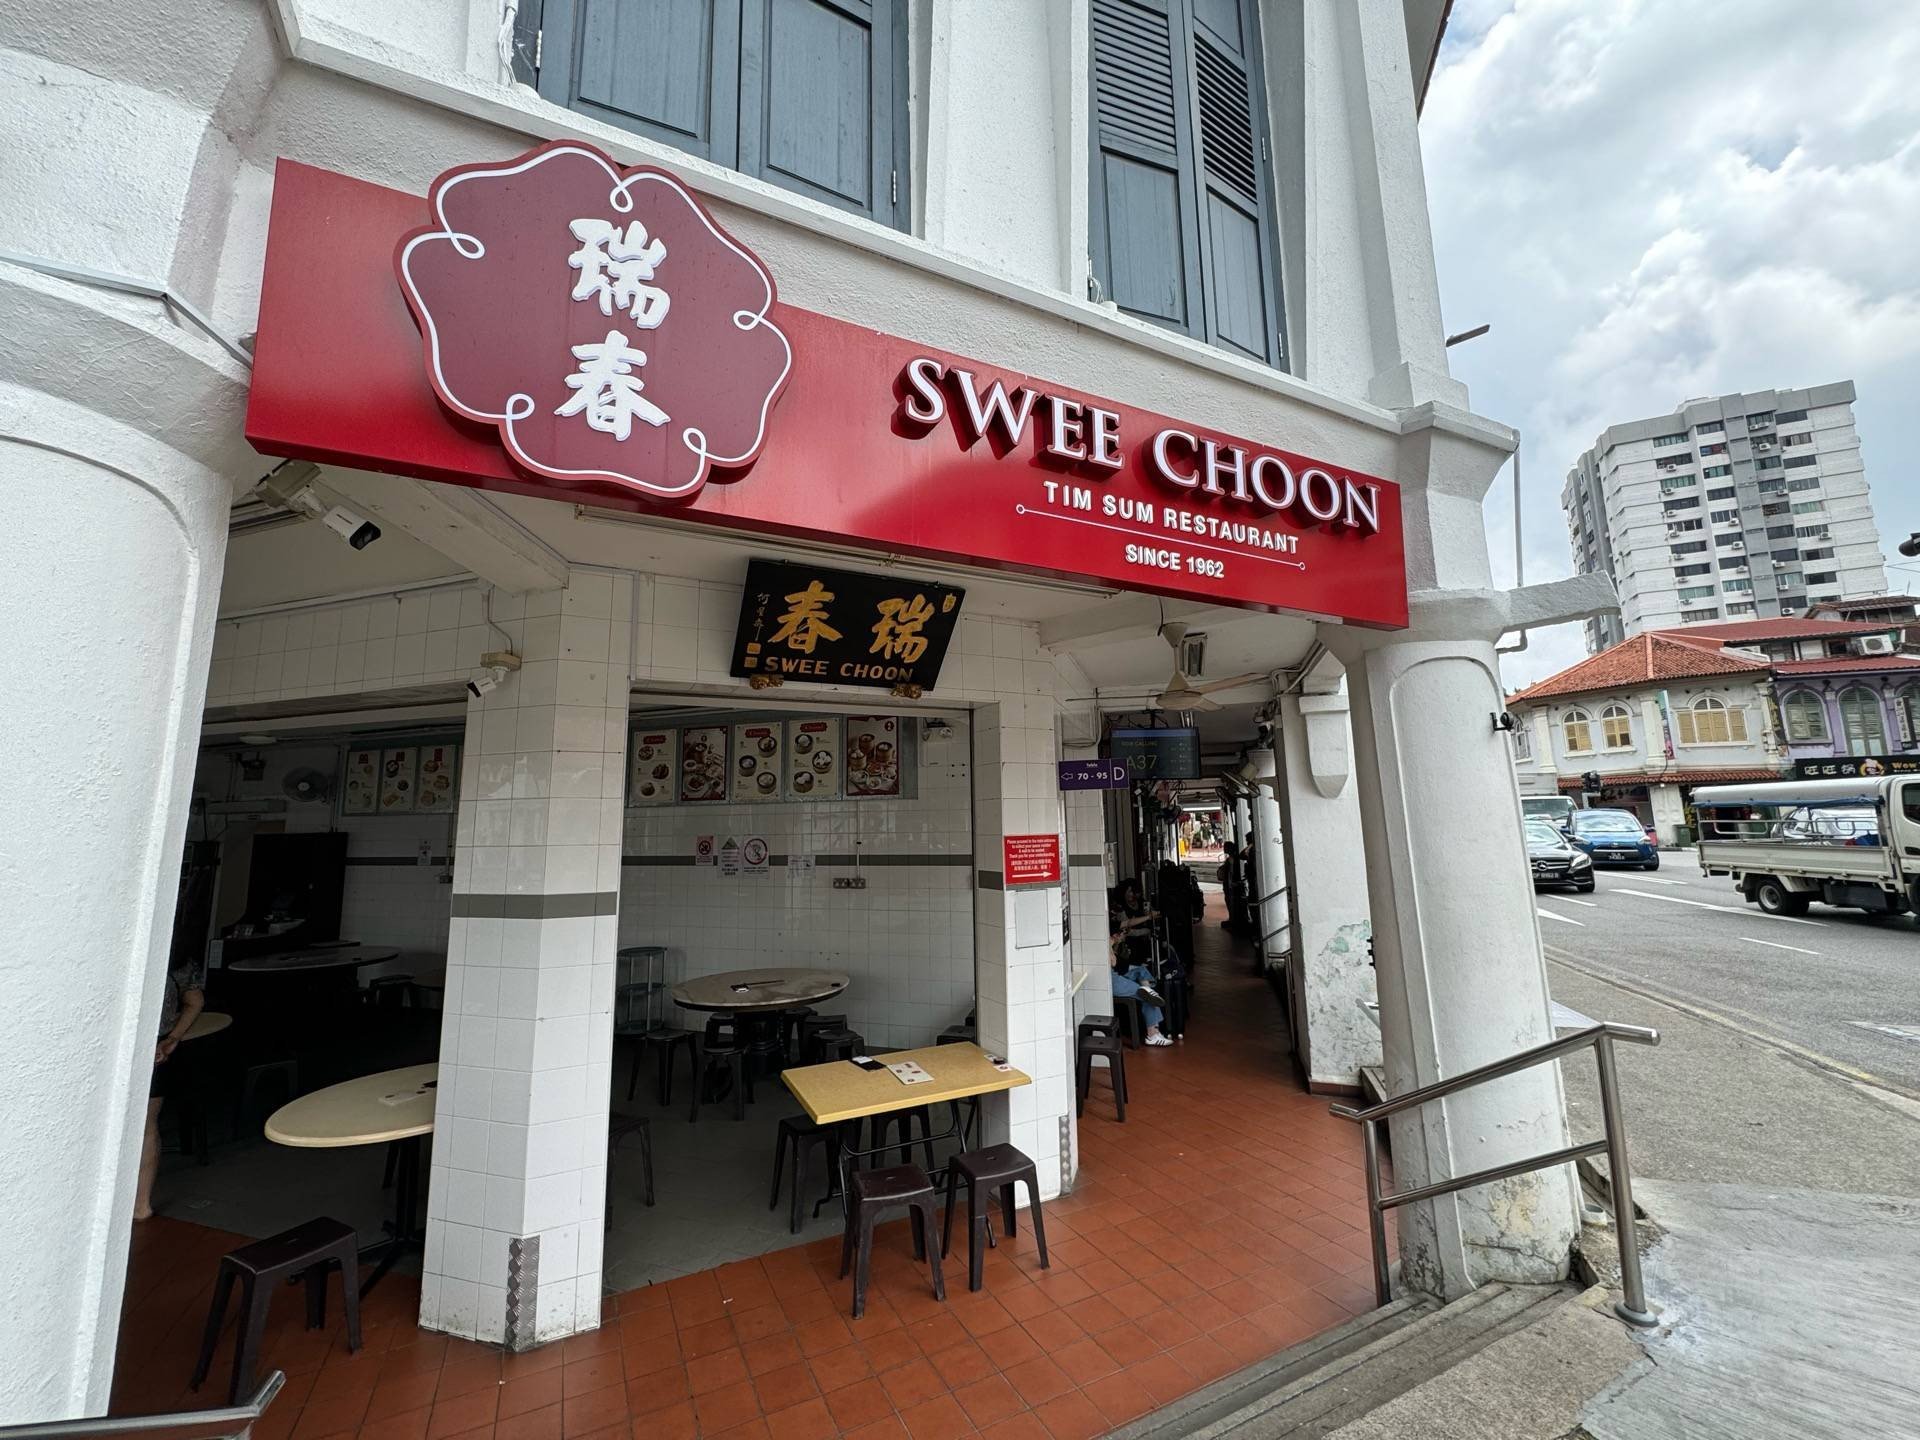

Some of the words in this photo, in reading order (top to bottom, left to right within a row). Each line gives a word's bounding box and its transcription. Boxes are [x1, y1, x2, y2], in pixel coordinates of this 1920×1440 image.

[554, 219, 671, 441] 瑞春
[904, 356, 1126, 470] SWEE
[1151, 427, 1382, 534] CHOON
[1043, 481, 1092, 511] TIM
[1103, 495, 1154, 525] SUM
[1164, 507, 1299, 555] RESTAURANT
[1125, 544, 1181, 571] SINCE
[1187, 556, 1225, 578] 1962
[764, 656, 830, 676] SWEE
[840, 663, 914, 681] CHOON
[1077, 772, 1089, 780] 70
[1096, 771, 1108, 780] 95
[1113, 766, 1125, 781] D
[1128, 754, 1158, 769] A37
